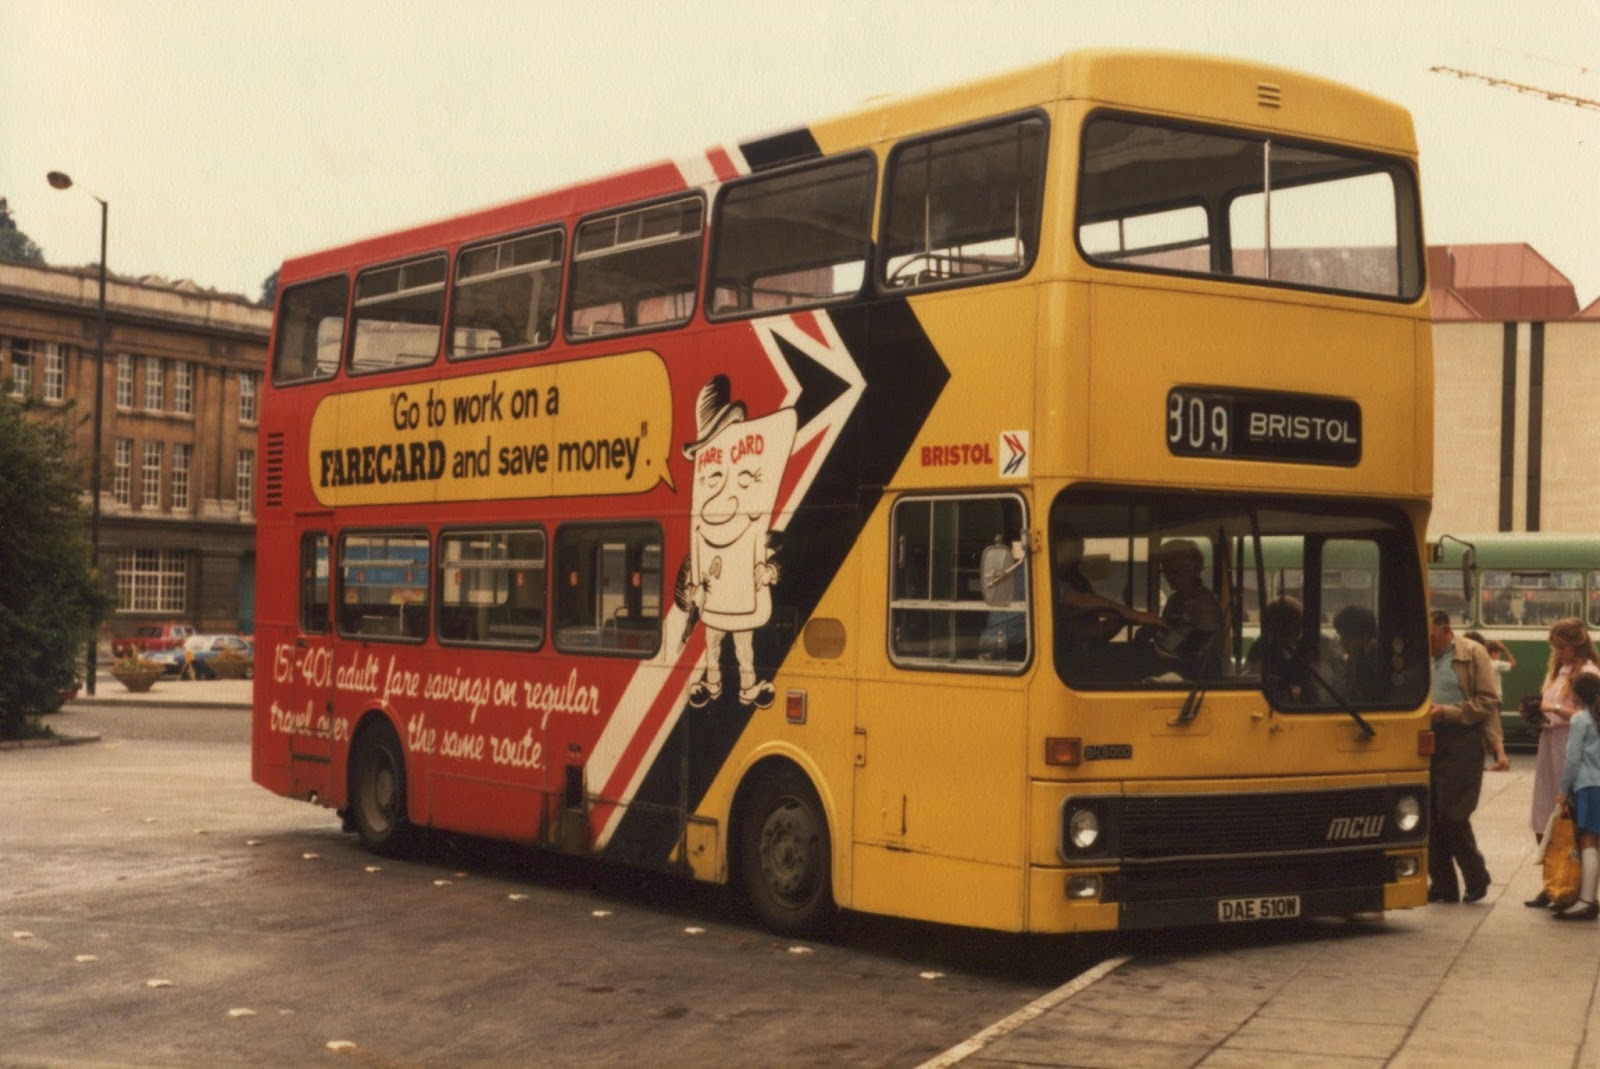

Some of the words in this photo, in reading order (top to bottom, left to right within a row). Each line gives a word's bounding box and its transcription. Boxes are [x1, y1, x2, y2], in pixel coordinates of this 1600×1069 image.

[427, 388, 446, 427] to
[453, 380, 503, 425] work
[510, 388, 538, 419] on
[545, 386, 559, 416] a
[1169, 393, 1228, 452] 309
[1250, 412, 1357, 443] BRISTOL
[320, 440, 446, 487] FARECARD
[452, 435, 491, 479] and
[498, 443, 548, 476] save
[698, 446, 723, 473] FARE
[730, 434, 764, 464] CARD
[921, 443, 993, 468] BRISTOL
[336, 651, 379, 692] adult
[381, 654, 420, 708] fare
[424, 667, 490, 724] savings
[493, 678, 517, 707] on
[525, 667, 600, 731] regular
[270, 700, 312, 736] travel
[317, 714, 350, 742] over
[408, 712, 436, 754] the
[440, 729, 484, 760] same
[1327, 815, 1384, 840] MCW
[1222, 900, 1256, 920] DAE
[1260, 897, 1297, 917] 510W
